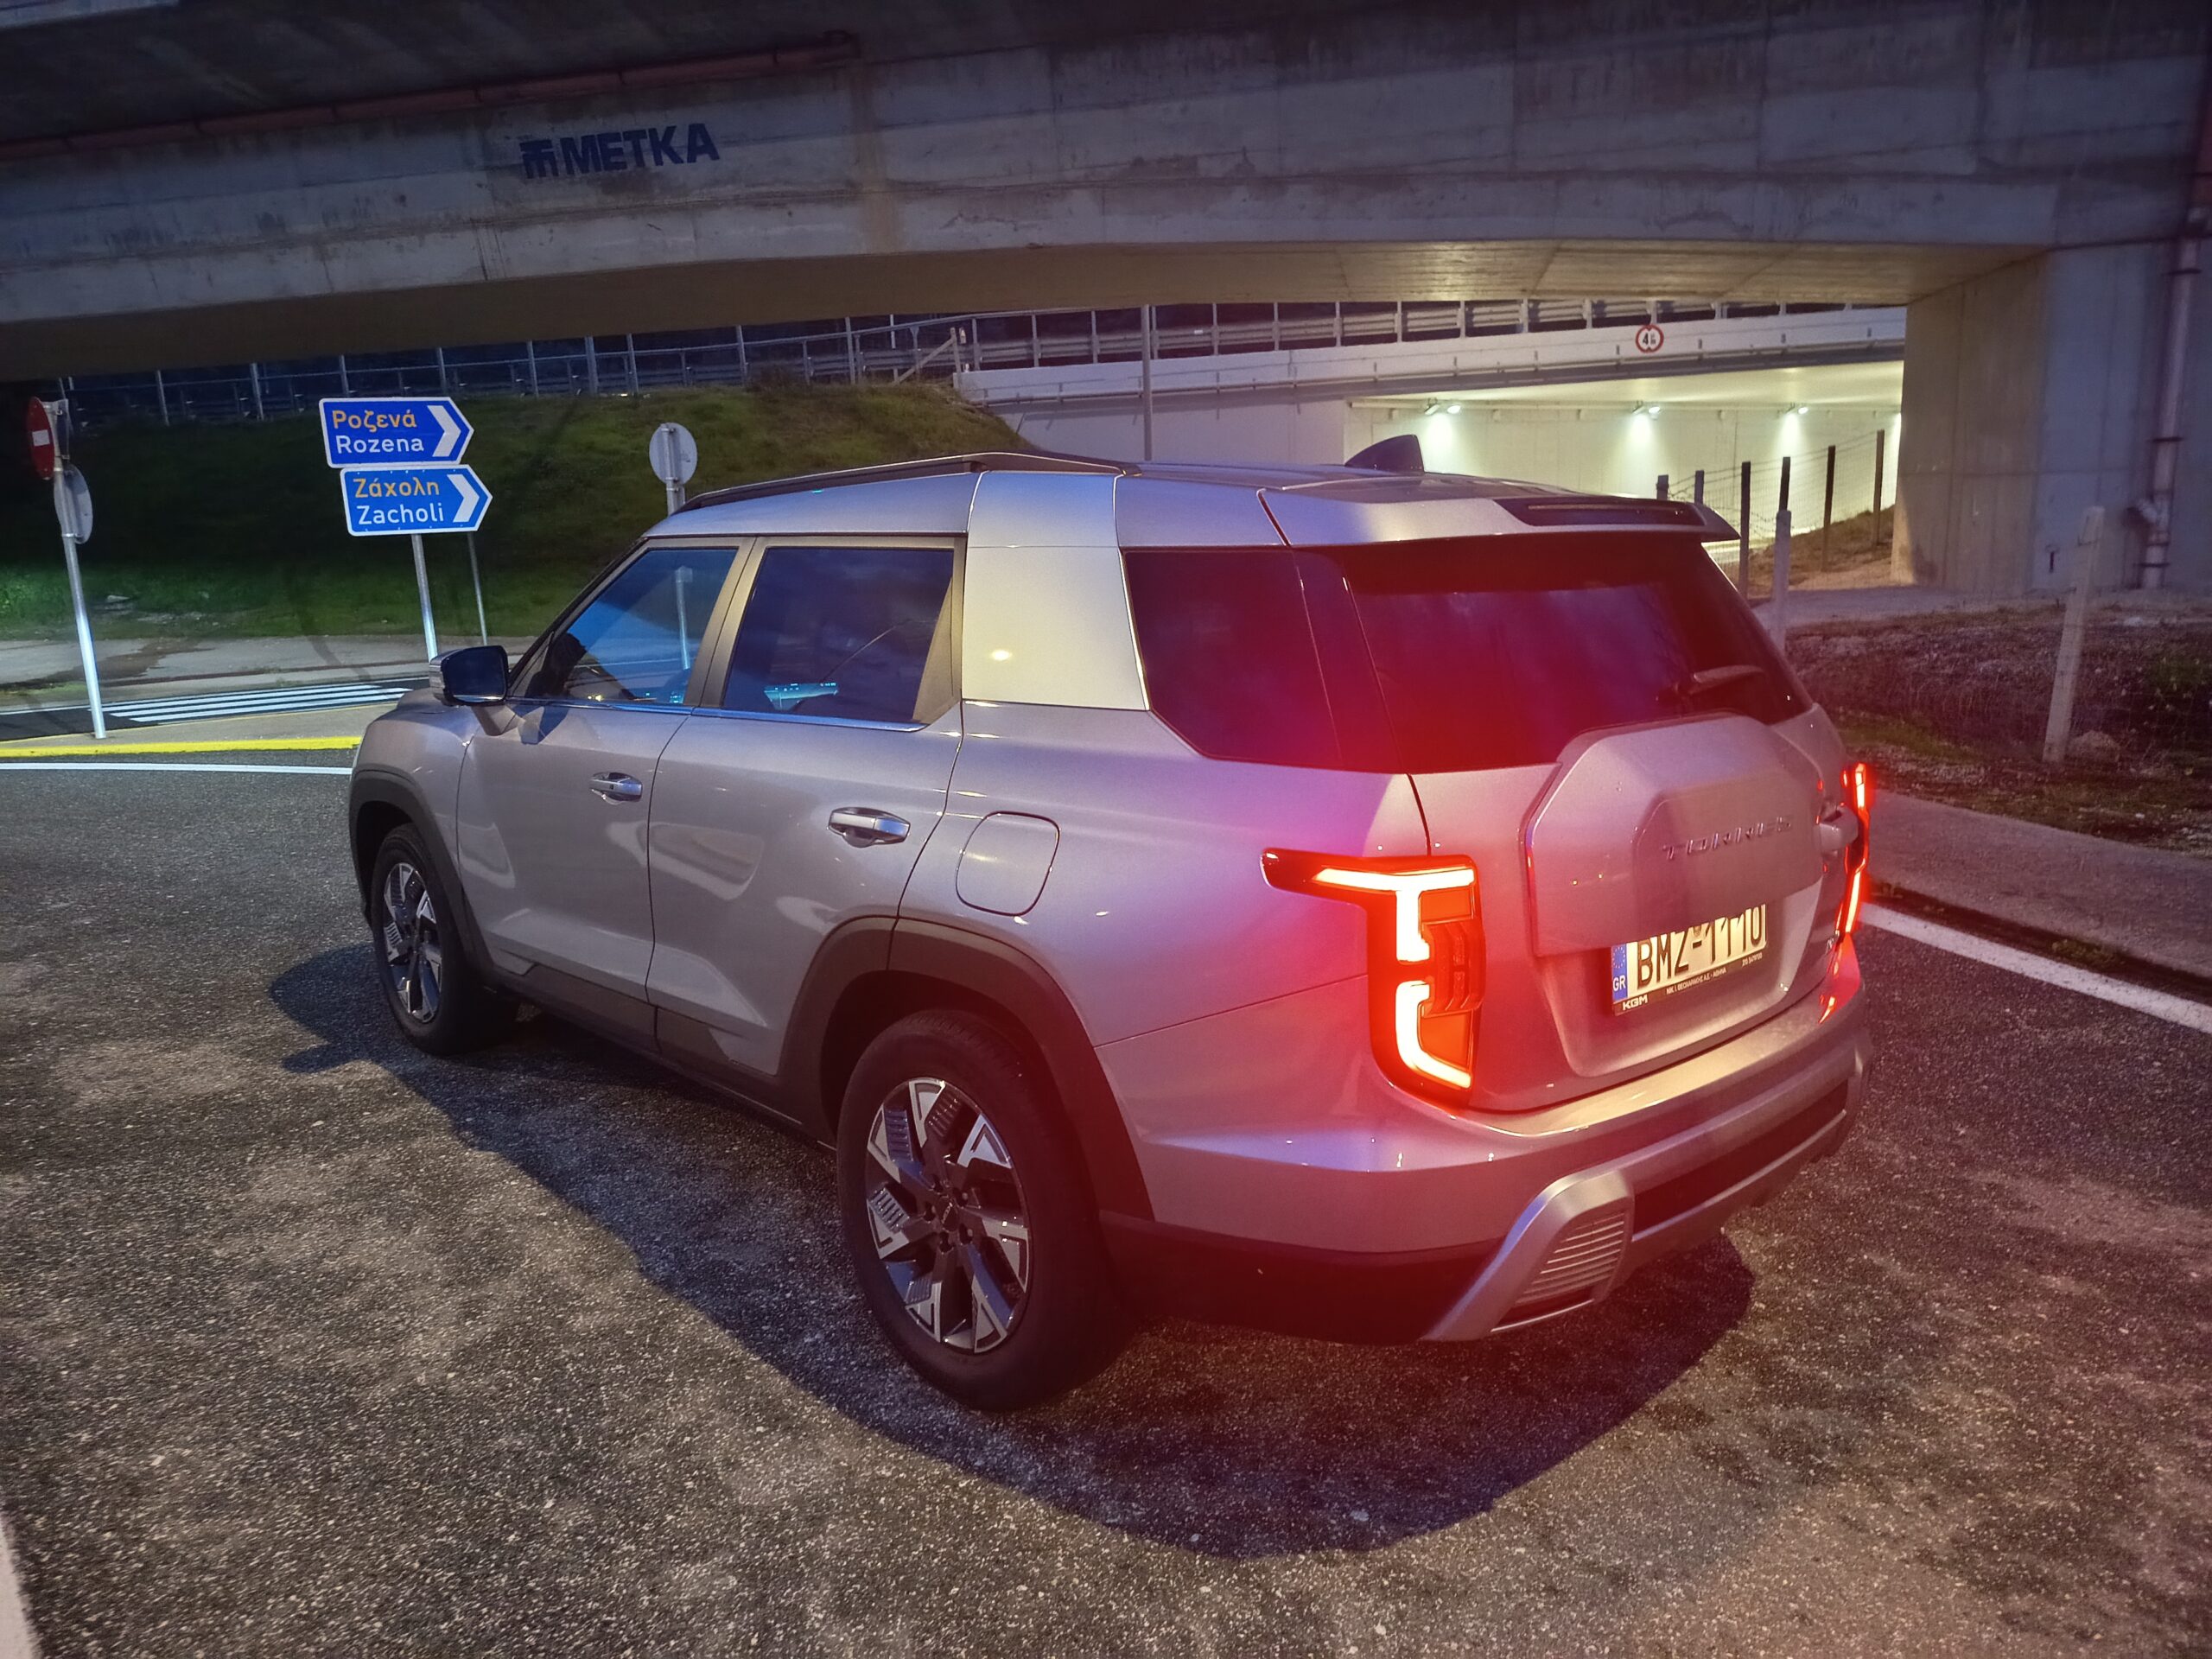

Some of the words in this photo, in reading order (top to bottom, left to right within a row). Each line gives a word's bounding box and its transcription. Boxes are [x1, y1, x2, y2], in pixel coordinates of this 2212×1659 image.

[559, 123, 720, 175] METKA
[332, 410, 417, 432] Ροζενά
[335, 435, 424, 454] Rozena
[353, 477, 440, 499] Ζάχολη
[356, 503, 444, 525] Zacholi
[1612, 975, 1626, 992] GR
[1623, 994, 1648, 1011] KGM
